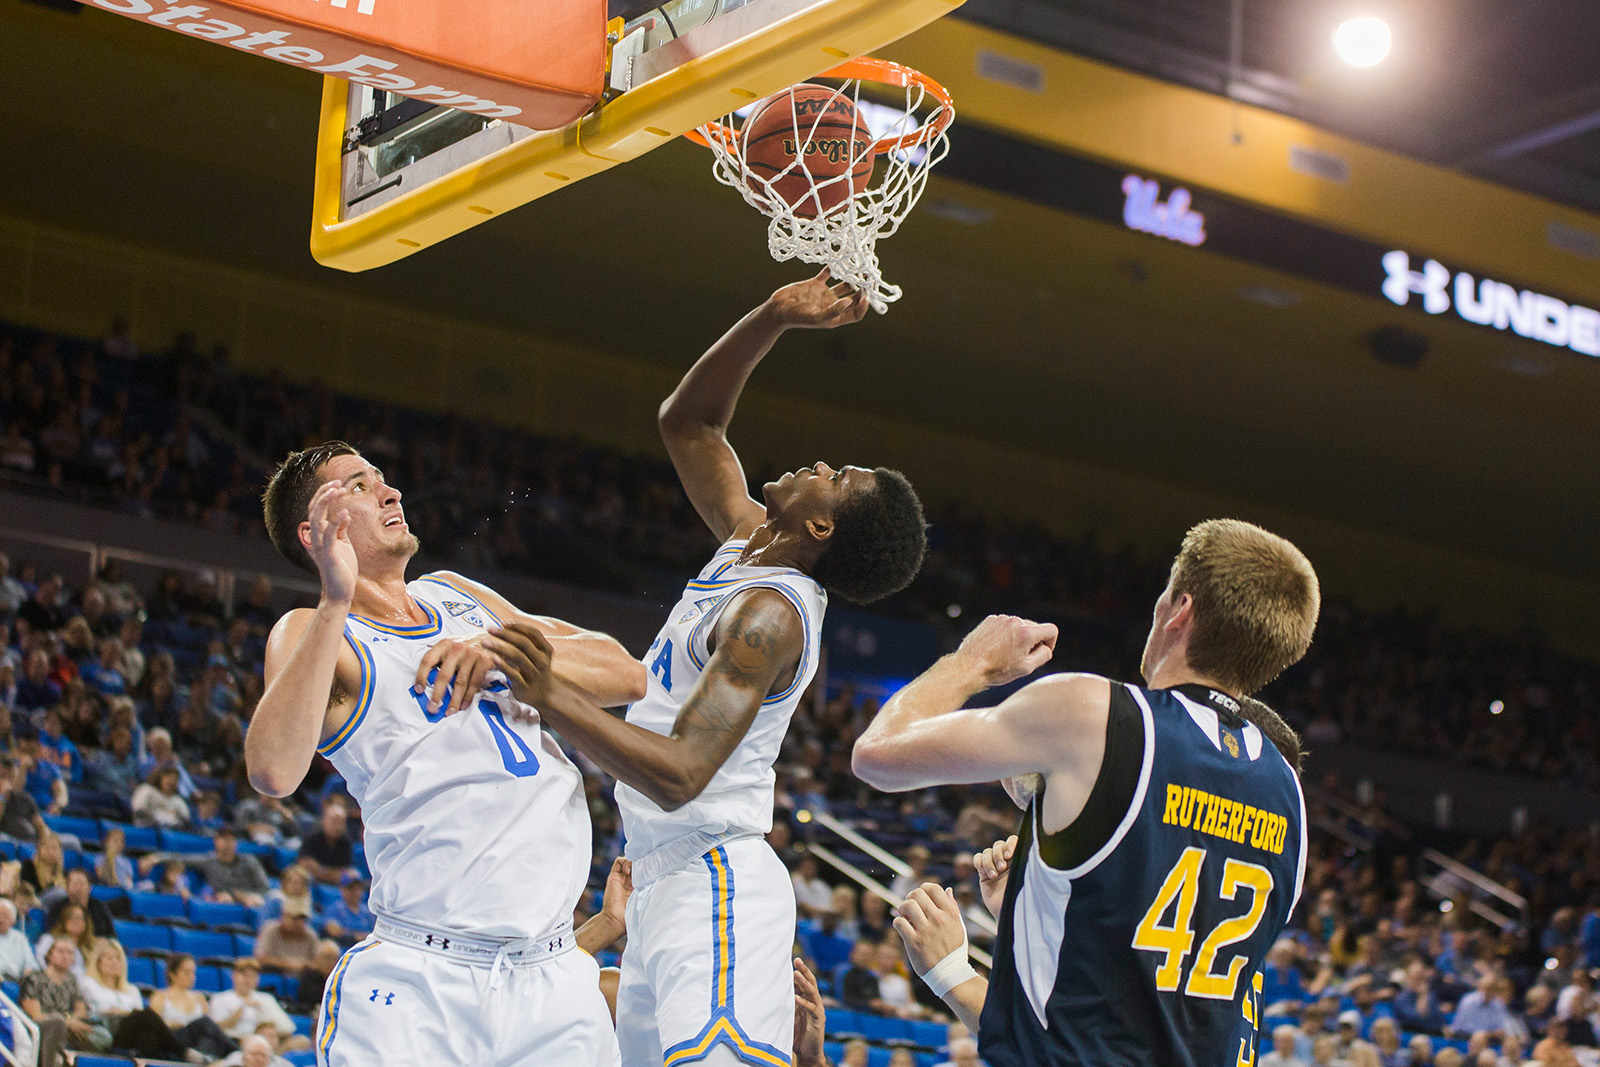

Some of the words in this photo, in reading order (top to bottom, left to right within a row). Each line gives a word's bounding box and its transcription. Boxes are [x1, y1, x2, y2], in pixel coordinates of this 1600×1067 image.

[308, 54, 522, 117] Farm
[795, 99, 853, 118] NCAA
[783, 139, 868, 165] Wilson
[478, 699, 540, 777] 0
[1162, 783, 1288, 855] RUTHERFORD
[1131, 846, 1274, 1000] 42
